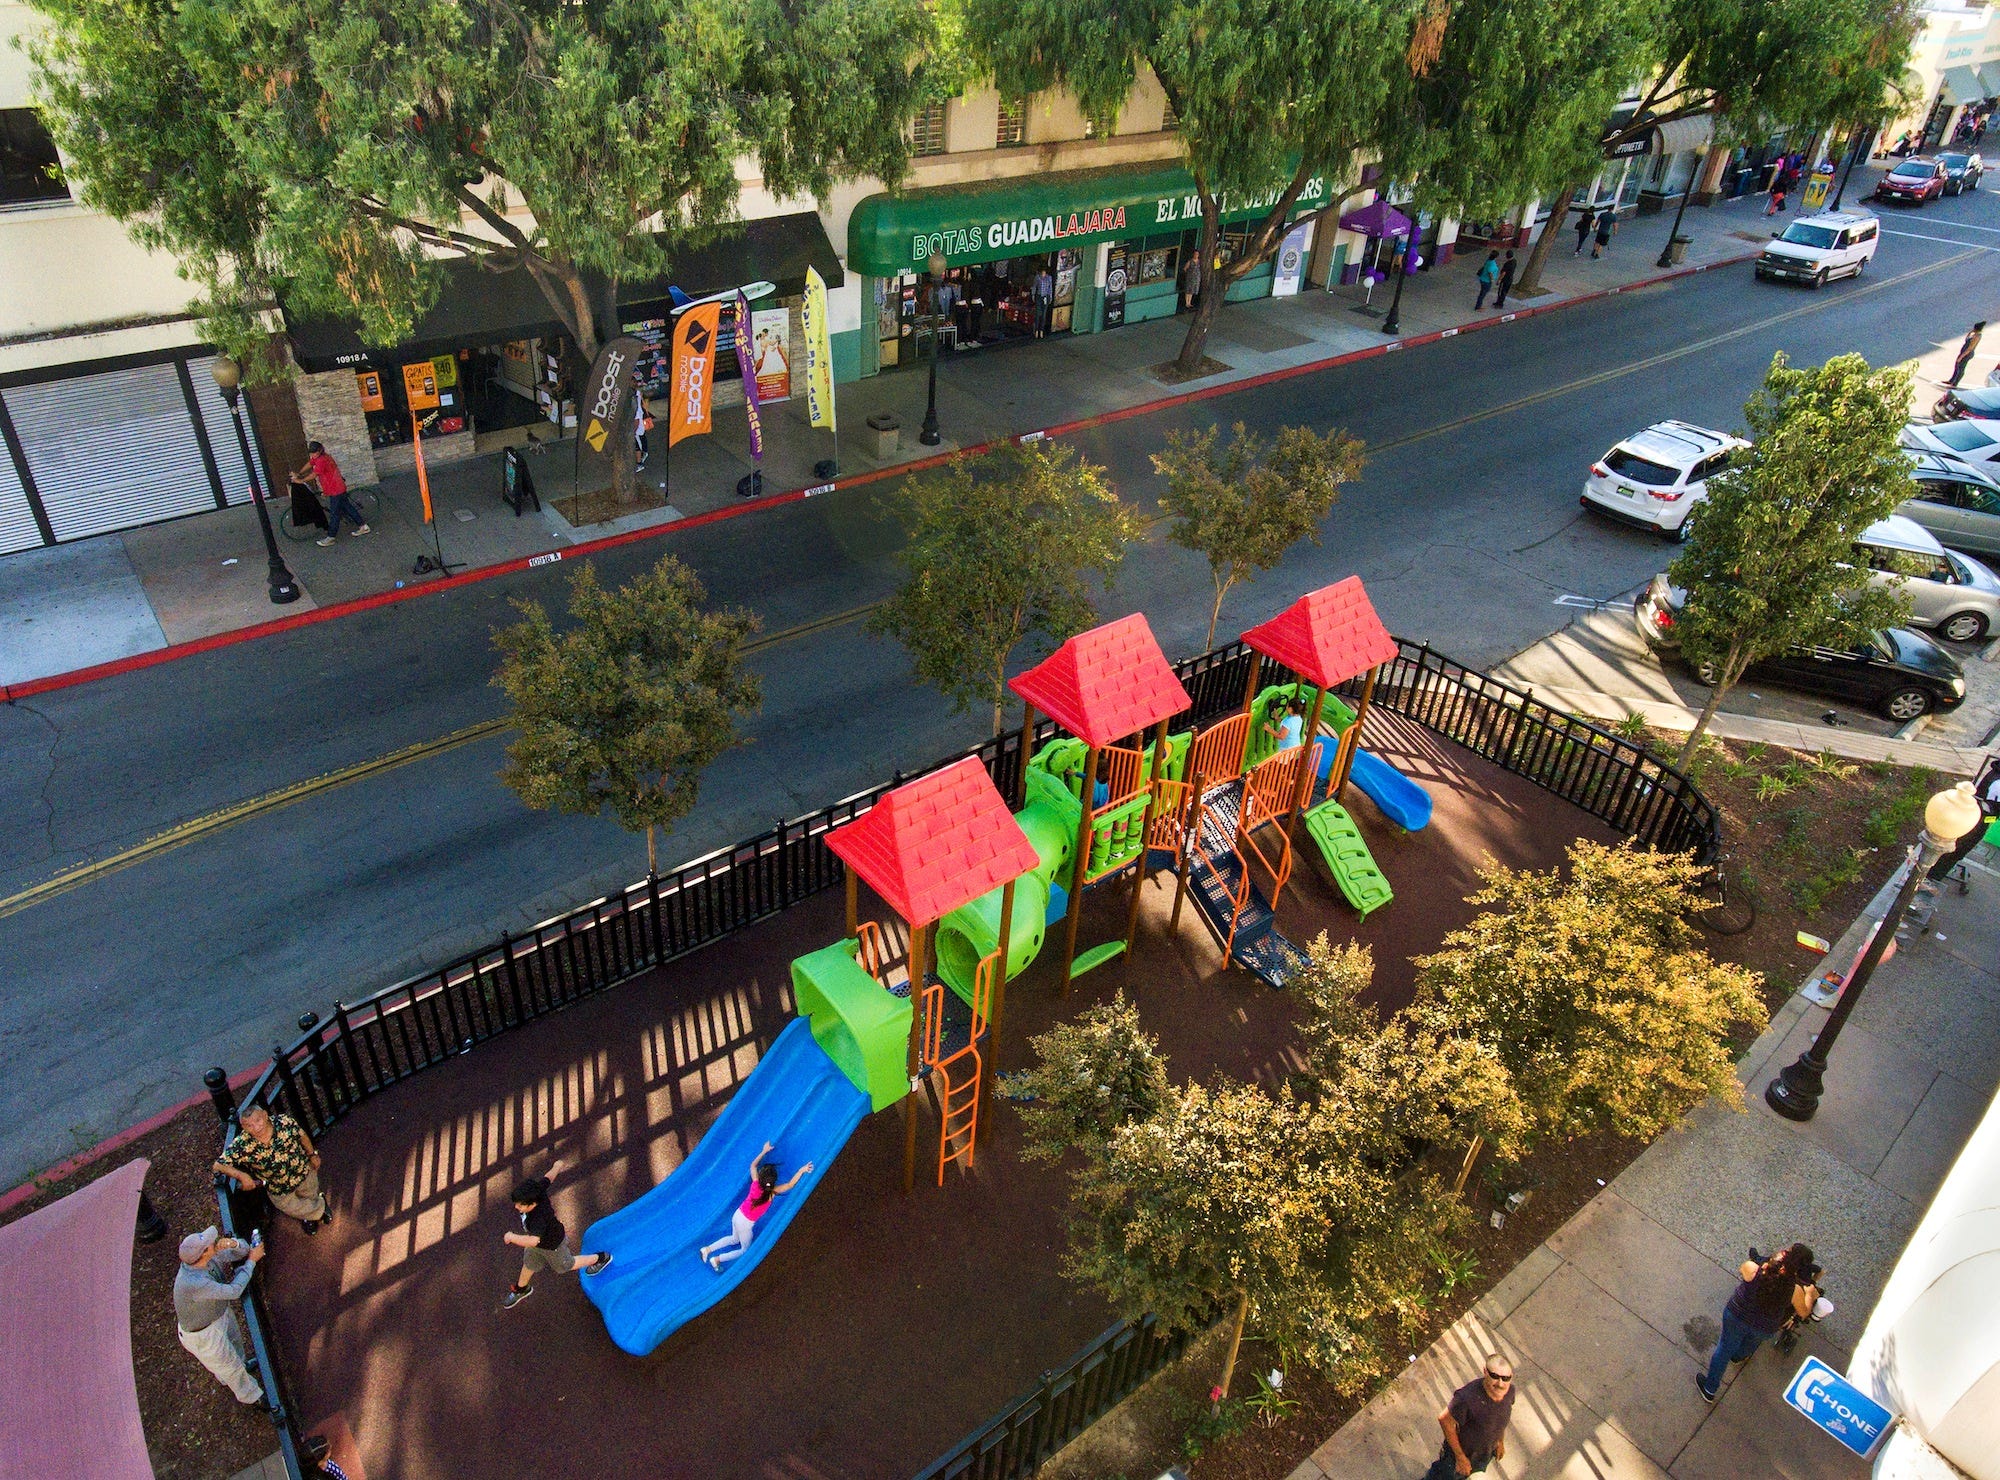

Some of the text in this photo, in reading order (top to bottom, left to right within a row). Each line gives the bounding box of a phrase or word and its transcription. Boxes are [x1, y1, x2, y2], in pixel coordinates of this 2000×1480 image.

[1155, 197, 1178, 223] EL
[913, 206, 1126, 261] BOTAS GUADALAJARA
[336, 353, 368, 364] 10918 A
[680, 355, 688, 393] mobile
[590, 350, 625, 418] boost
[687, 356, 707, 425] boost
[607, 387, 621, 423] mobile
[530, 556, 551, 566] 10918
[1810, 1386, 1879, 1438] PHONE
